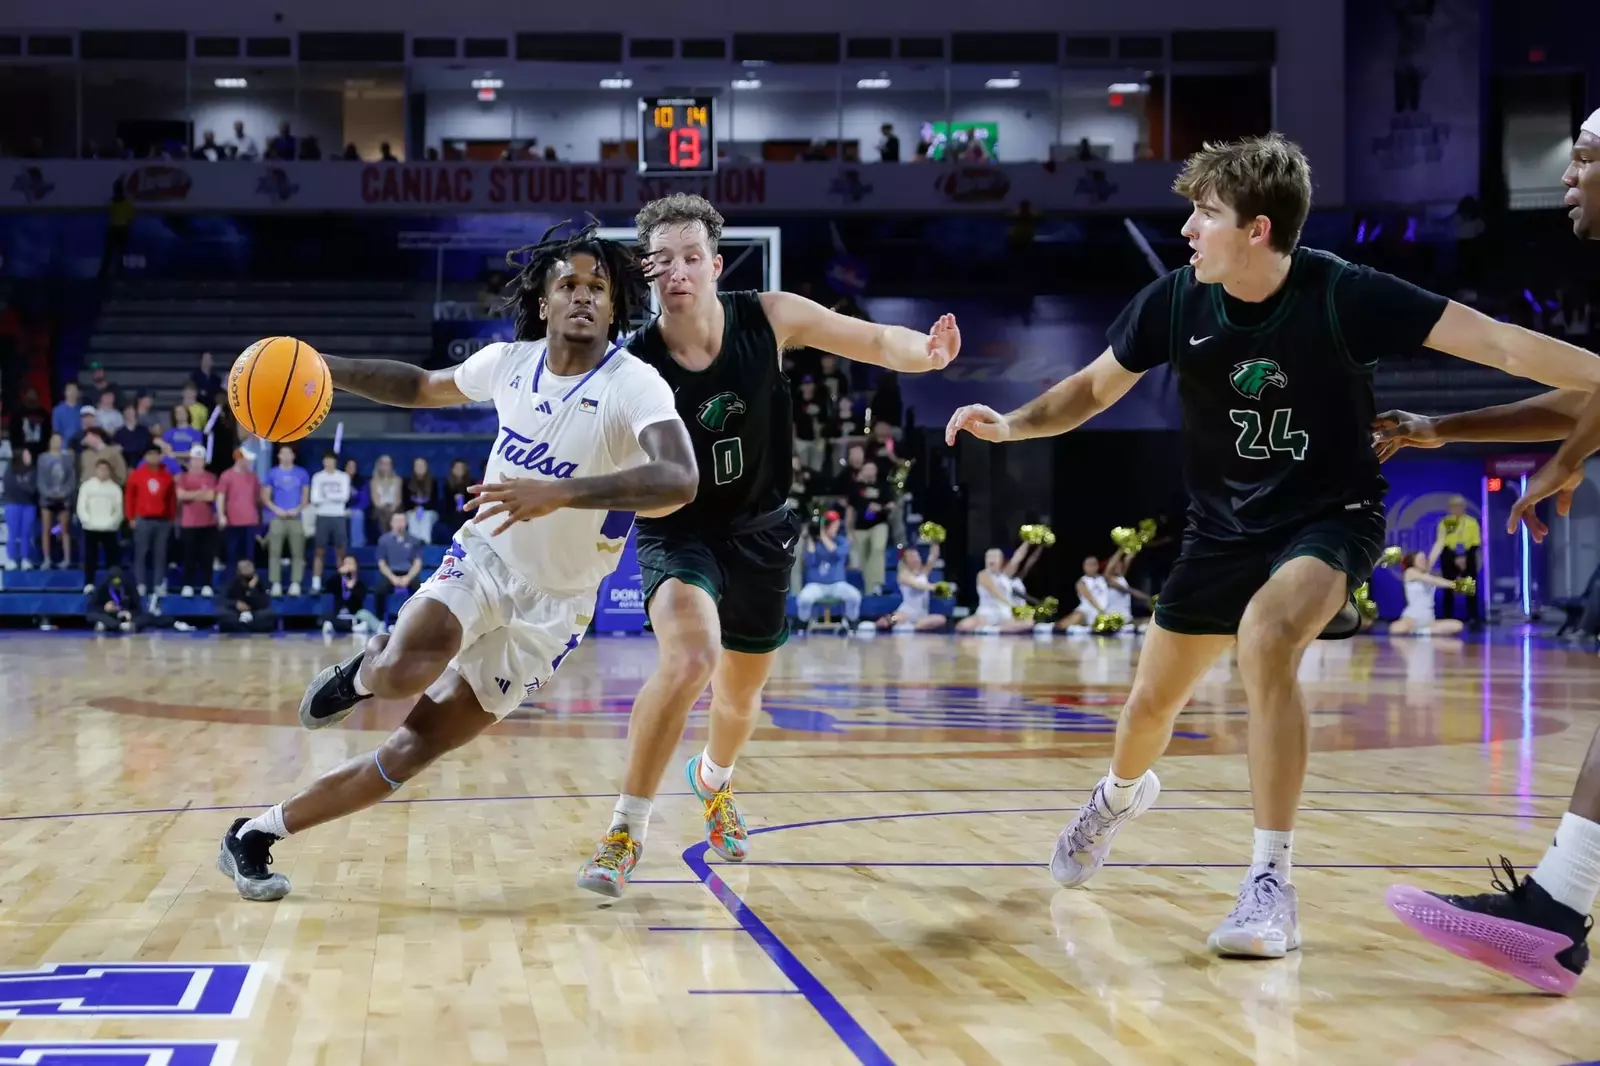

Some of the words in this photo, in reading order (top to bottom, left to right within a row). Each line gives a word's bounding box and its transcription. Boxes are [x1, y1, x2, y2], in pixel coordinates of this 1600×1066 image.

[654, 106, 673, 128] 10
[687, 106, 708, 128] 14
[669, 127, 701, 168] 13
[361, 166, 473, 203] CANIAC
[488, 167, 628, 203] STUDENT
[496, 426, 579, 479] Tulsa
[1229, 407, 1309, 461] 24
[711, 436, 744, 486] 0
